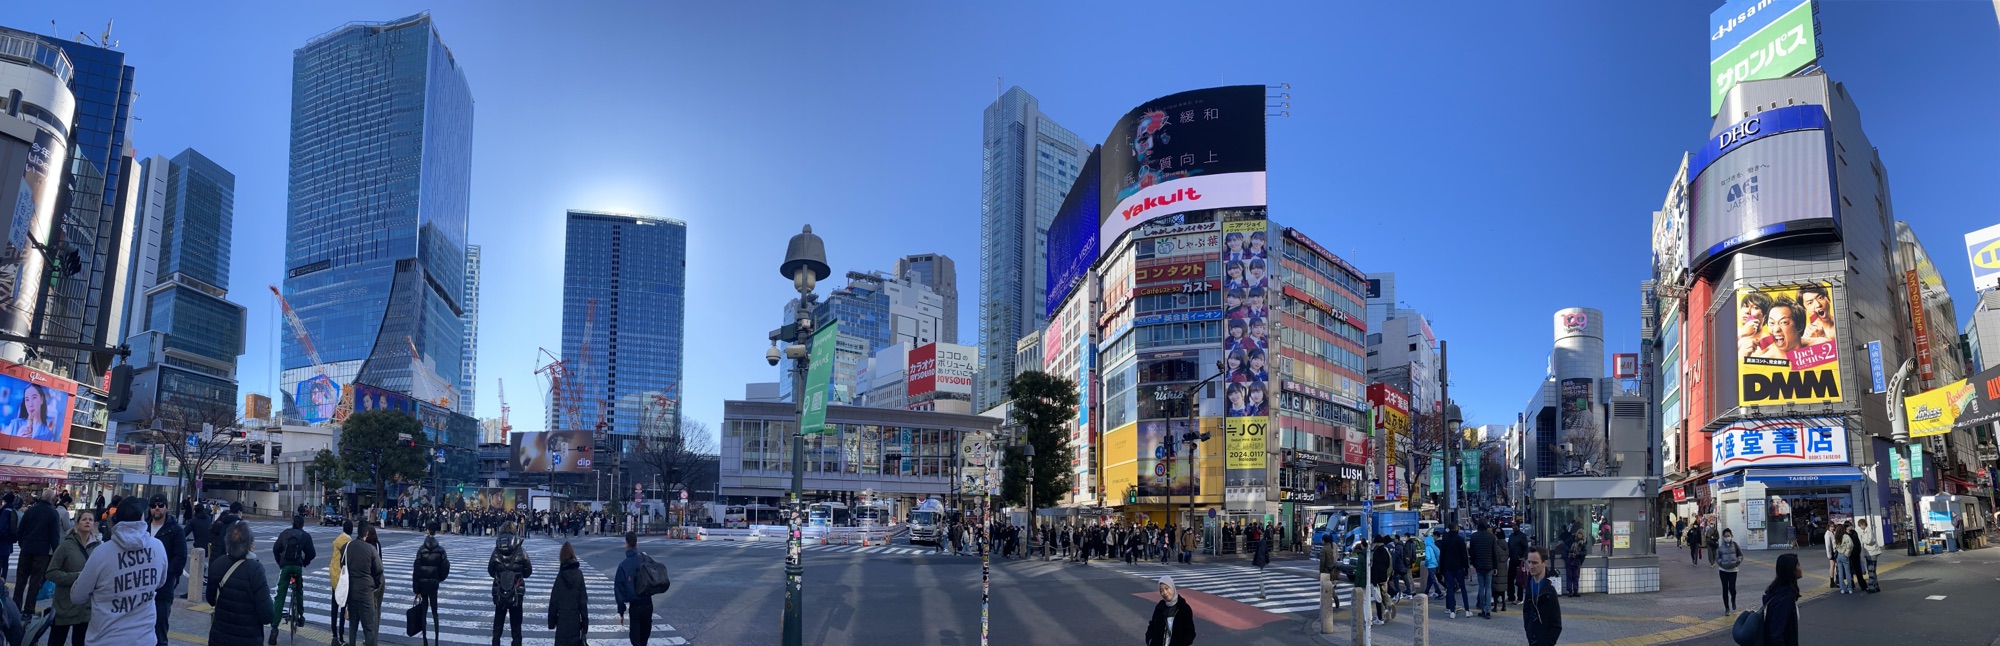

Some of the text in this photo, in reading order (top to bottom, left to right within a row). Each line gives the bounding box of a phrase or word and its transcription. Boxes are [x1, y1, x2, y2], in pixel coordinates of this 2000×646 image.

[1712, 0, 1776, 40] Hisam
[1716, 23, 1807, 95] サロンパス
[1719, 118, 1761, 150] DHC
[1121, 187, 1202, 221] Yakult
[1136, 264, 1203, 280] コンタクト
[1182, 281, 1213, 294] ガスト
[937, 350, 969, 361] ココロの
[909, 358, 935, 375] カラオケ
[29, 372, 48, 383] Glico
[937, 375, 972, 386] JOYSOUN
[1742, 369, 1840, 402] DMM
[1349, 443, 1364, 454] アコム
[1715, 426, 1833, 462] 大盛堂書店
[577, 457, 591, 467] dip
[1341, 467, 1363, 480] LUSH
[114, 567, 158, 594] NEVER
[110, 594, 138, 614] SAY
